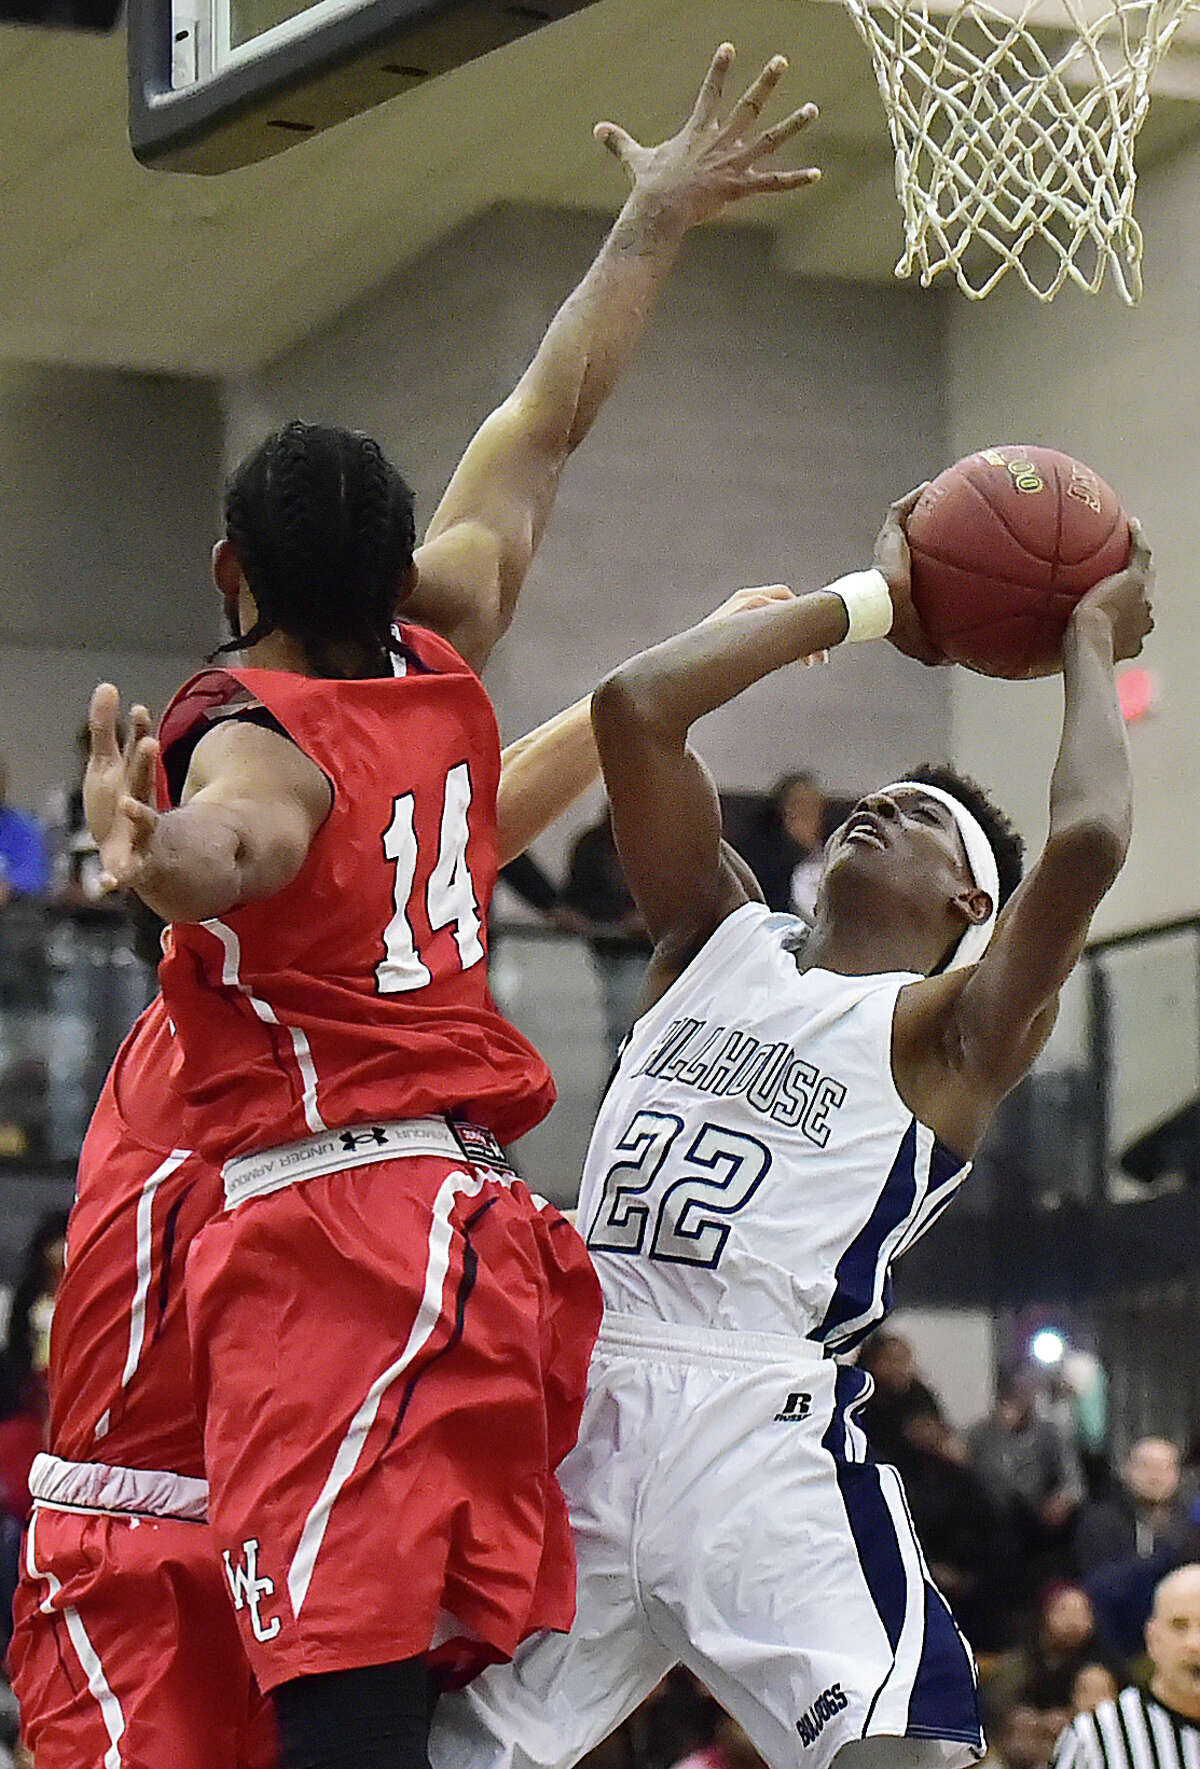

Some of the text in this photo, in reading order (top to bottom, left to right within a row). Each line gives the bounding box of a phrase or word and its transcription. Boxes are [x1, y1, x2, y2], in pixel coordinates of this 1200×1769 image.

[375, 760, 484, 993] 14
[228, 1141, 335, 1192] UNDER ARMOU
[587, 1110, 772, 1270] 22
[222, 1539, 280, 1642] WC
